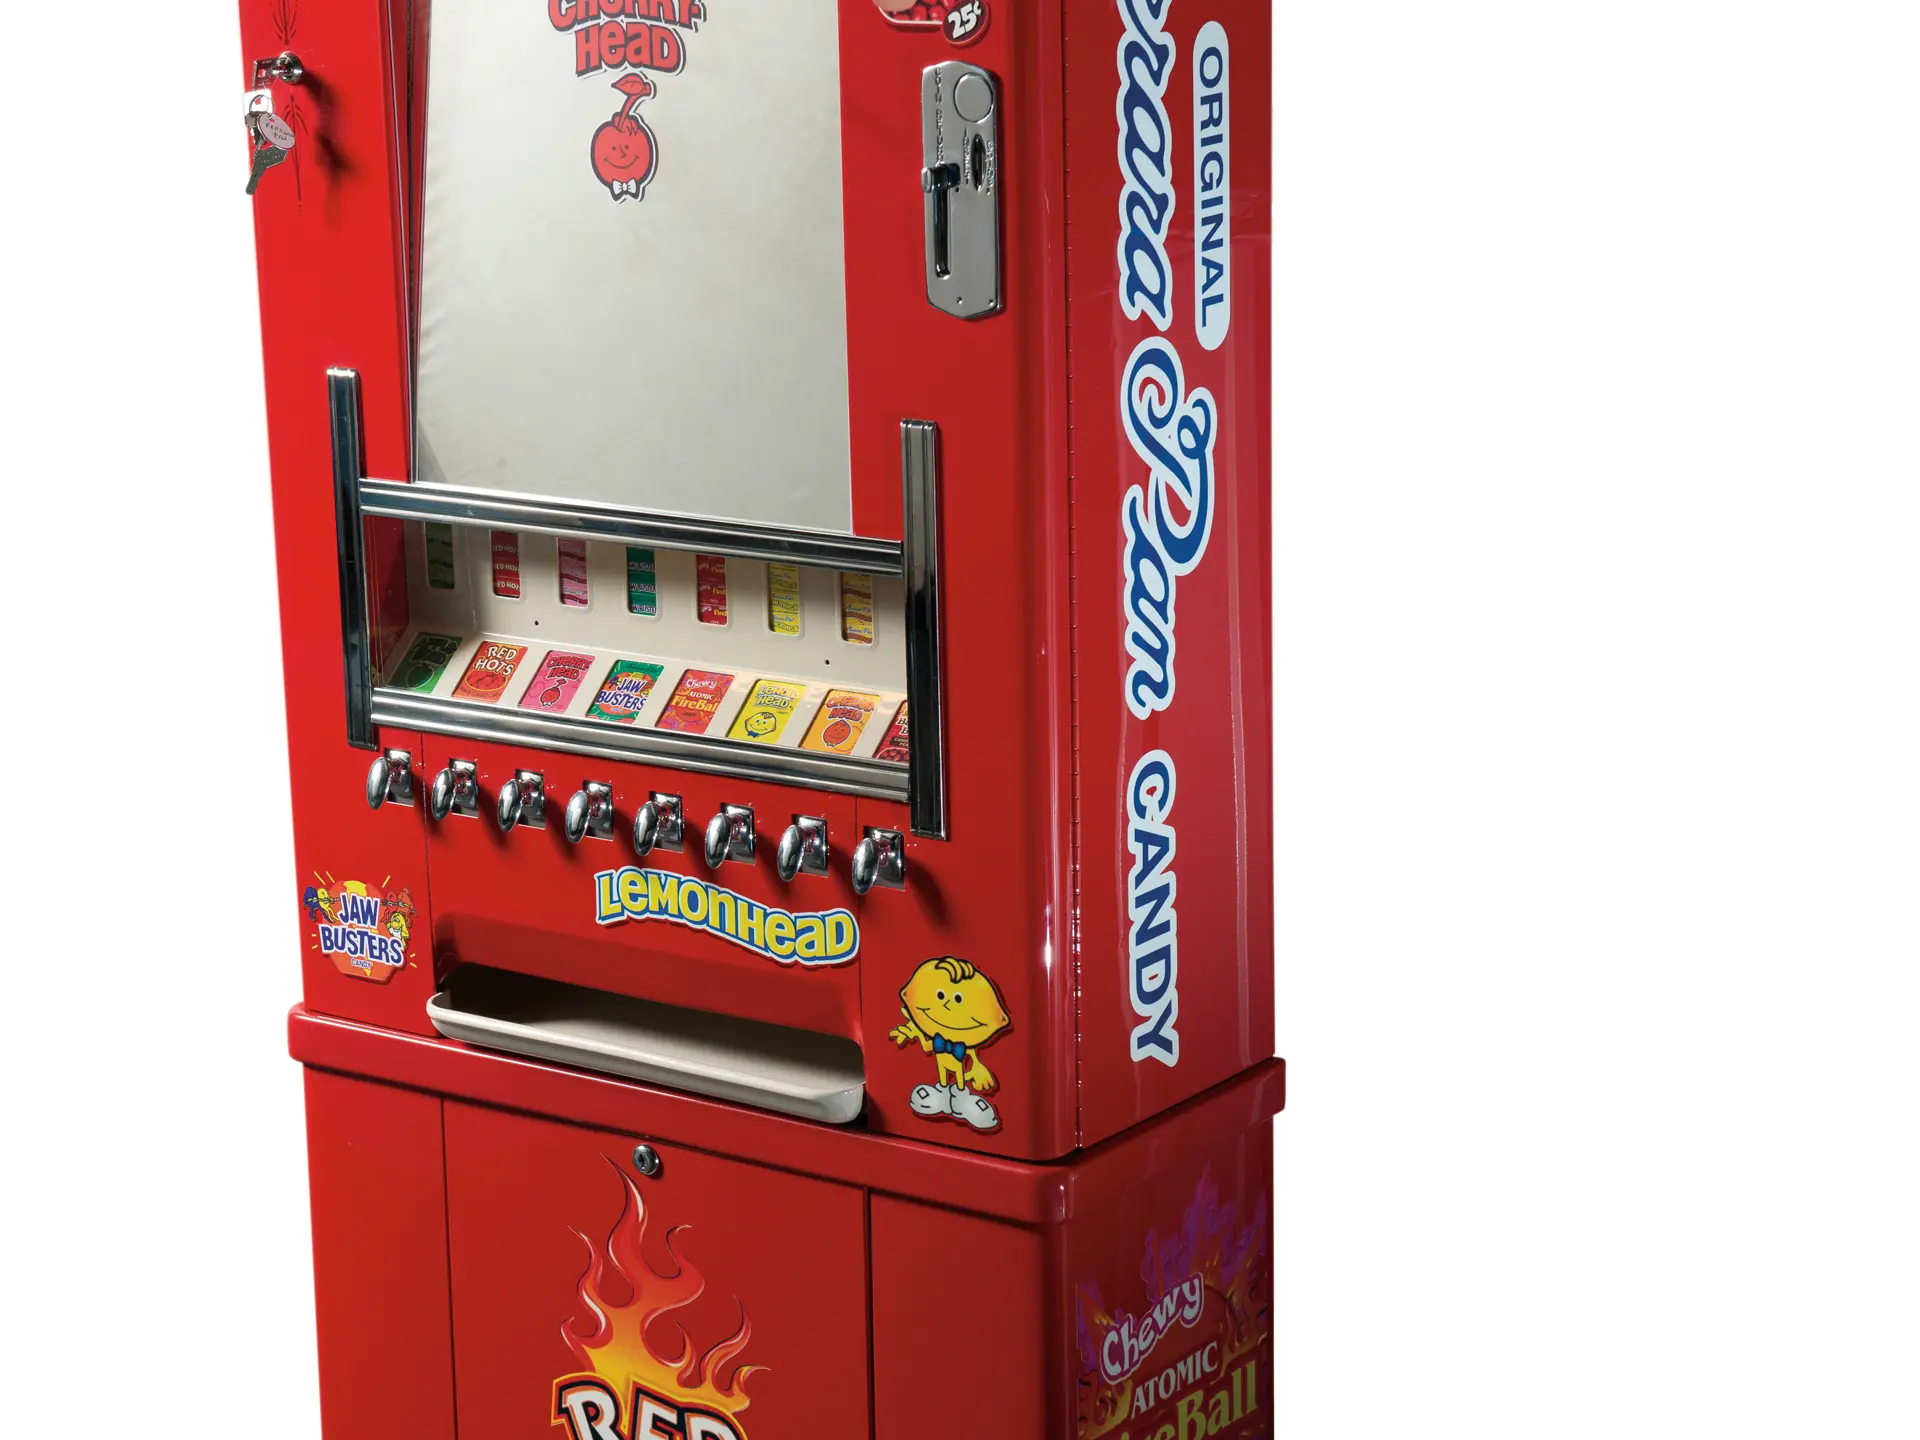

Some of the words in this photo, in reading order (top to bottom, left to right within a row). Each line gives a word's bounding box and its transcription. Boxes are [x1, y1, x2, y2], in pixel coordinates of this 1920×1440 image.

[1200, 47, 1224, 328] ORIGINAL
[1127, 347, 1211, 708] Pan
[487, 646, 517, 660] RED
[474, 658, 515, 677] HOTS
[617, 678, 646, 693] JAW
[686, 679, 717, 690] Chewy
[688, 691, 715, 700] ATOMIC
[596, 691, 647, 711] BUSTERS
[671, 695, 719, 712] FireBal
[339, 894, 379, 927] JAW
[1134, 760, 1173, 1056] CANDY
[320, 926, 402, 964] BUSTERS
[1103, 1278, 1200, 1376] Chewy
[1131, 1341, 1218, 1420] ATOMIC
